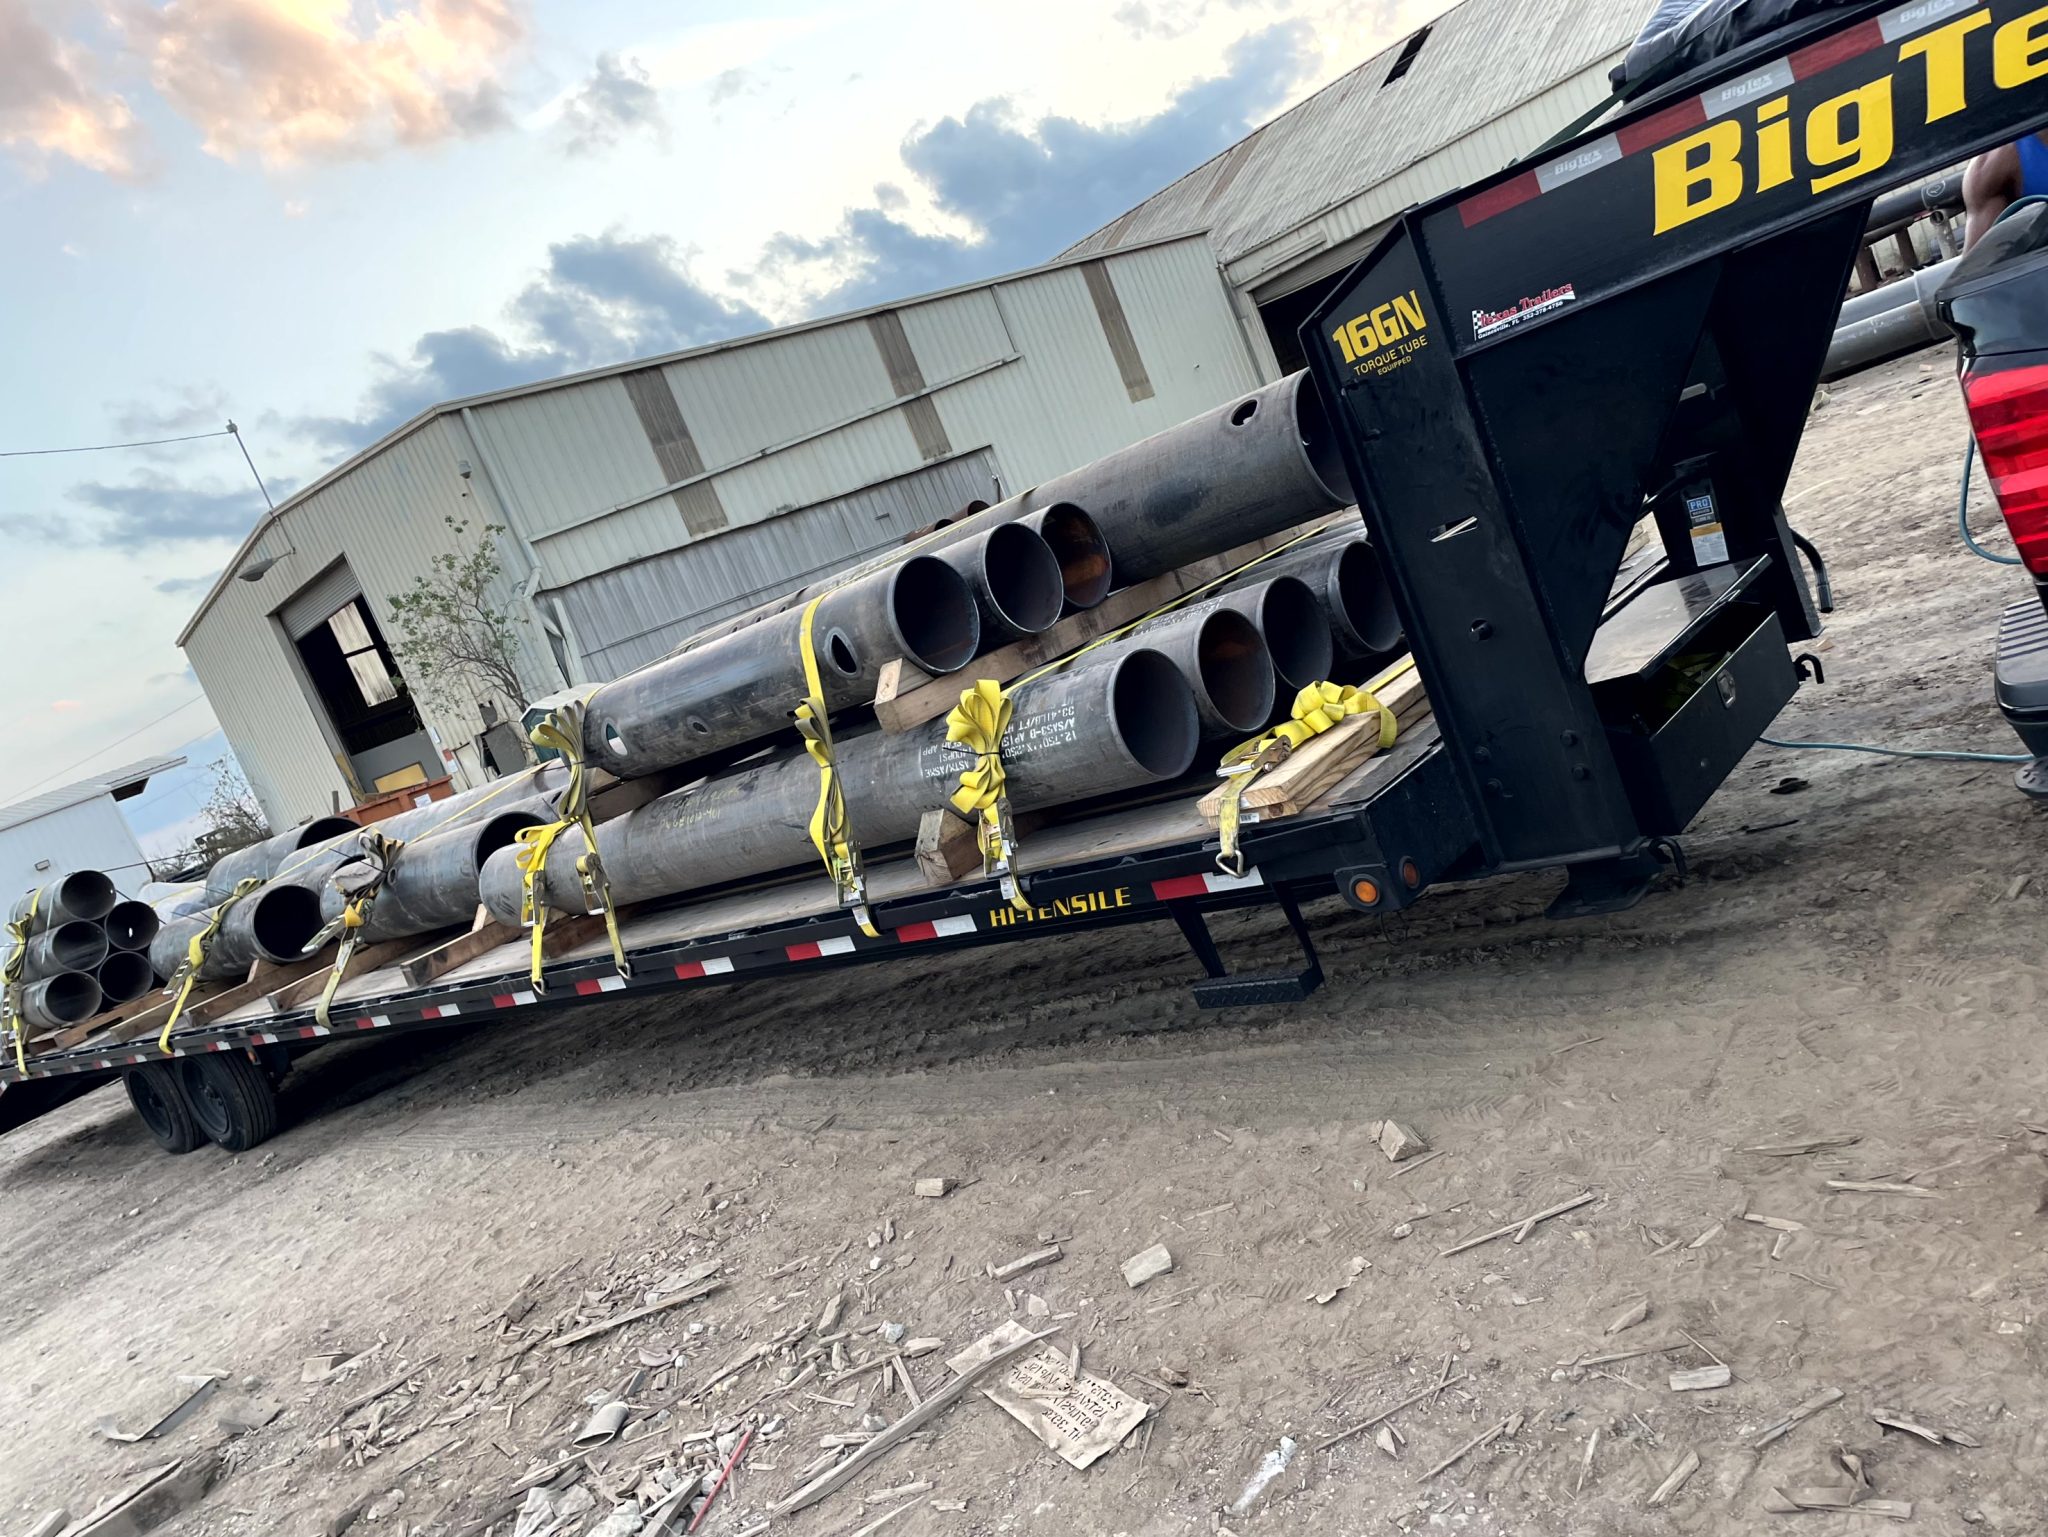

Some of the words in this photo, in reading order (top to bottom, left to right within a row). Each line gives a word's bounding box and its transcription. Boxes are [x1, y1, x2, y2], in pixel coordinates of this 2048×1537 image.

[1721, 73, 1772, 101] BigTex
[1554, 149, 1602, 175] BigTex
[1480, 306, 1518, 328] Texas
[1519, 283, 1573, 311] Trailers
[1332, 289, 1427, 364] 16GN
[1353, 349, 1398, 376] TORQUE
[1398, 334, 1428, 356] TUBE
[1377, 355, 1412, 376] EQUIPPED
[1690, 498, 1709, 510] PRO
